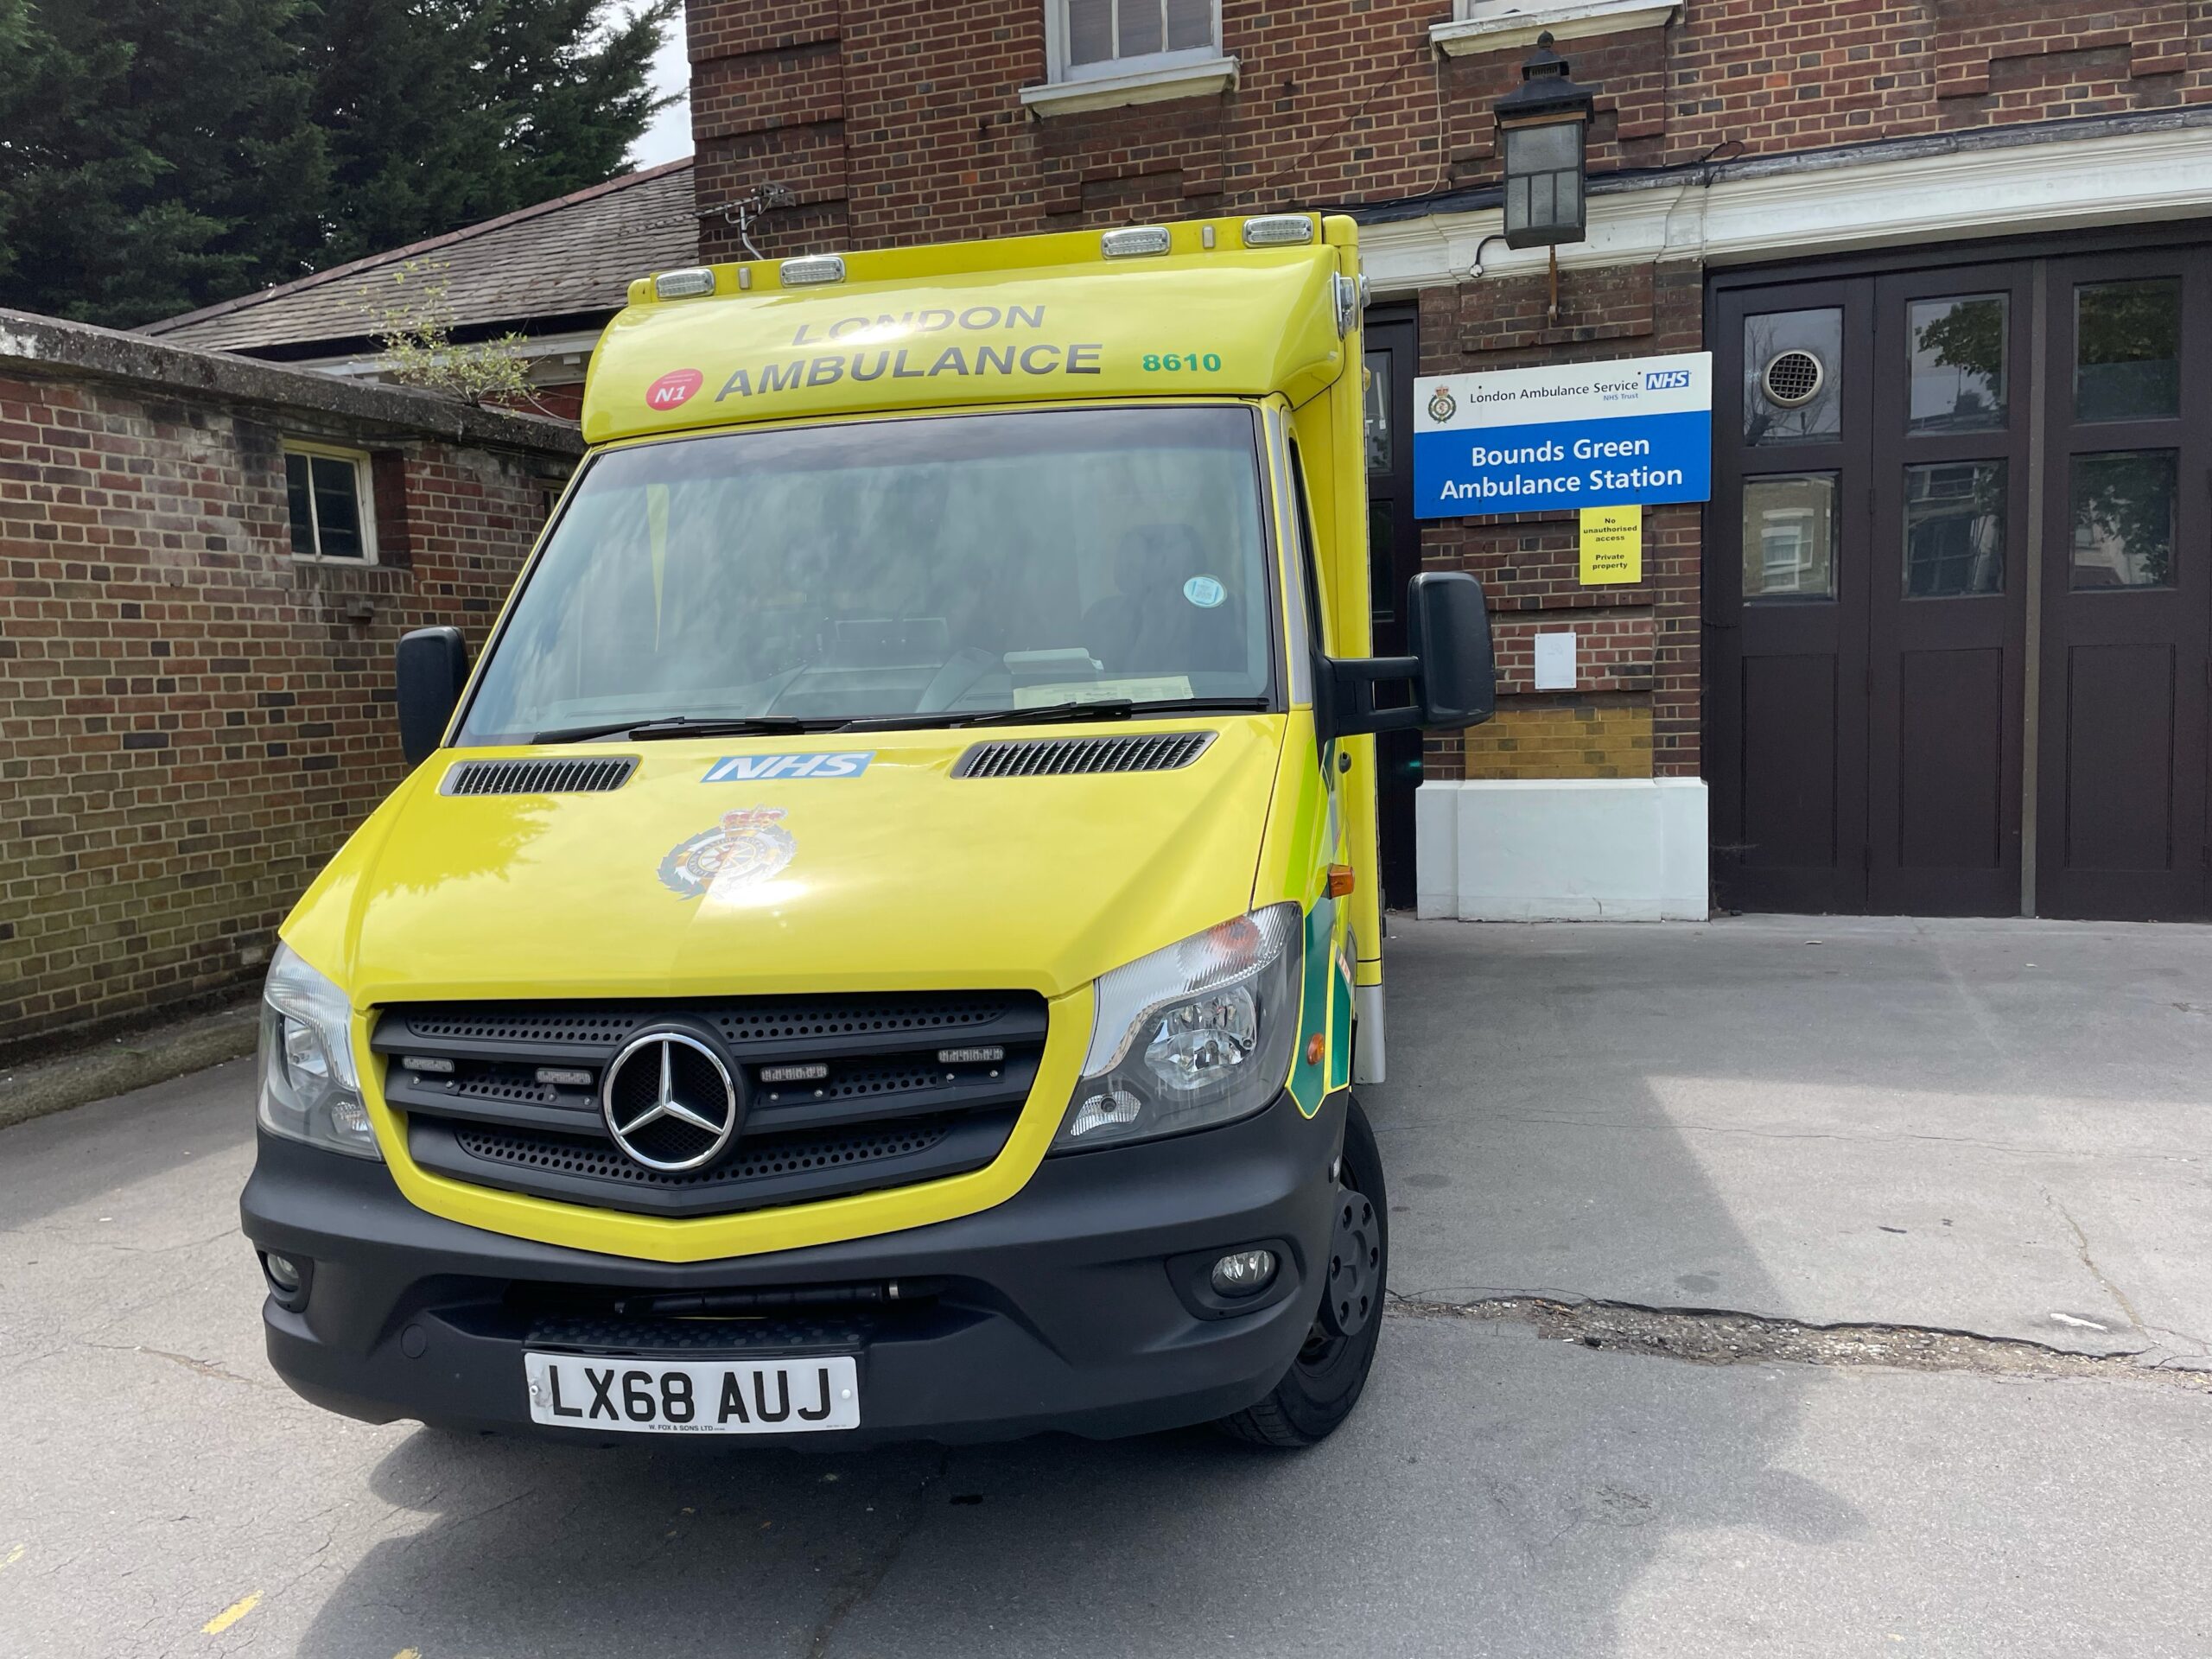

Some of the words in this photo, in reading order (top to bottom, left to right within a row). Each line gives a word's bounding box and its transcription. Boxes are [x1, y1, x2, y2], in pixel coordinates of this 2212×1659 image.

[791, 305, 1046, 346] LONDON
[714, 343, 1103, 403] AMBULANCE
[1141, 353, 1222, 372] 8610
[654, 385, 686, 404] N1
[1470, 391, 1516, 404] London
[1520, 385, 1590, 400] Ambulance
[1593, 380, 1639, 393] Service
[1647, 371, 1688, 390] NHS
[1471, 440, 1565, 467] Bounds
[1573, 438, 1650, 460] Green
[1440, 474, 1581, 500] Ambulance
[1589, 466, 1683, 491] Station
[1583, 525, 1637, 534] unauthorised
[706, 753, 870, 781] NHS
[548, 1364, 695, 1423] LX68
[717, 1368, 832, 1424] AUJ
